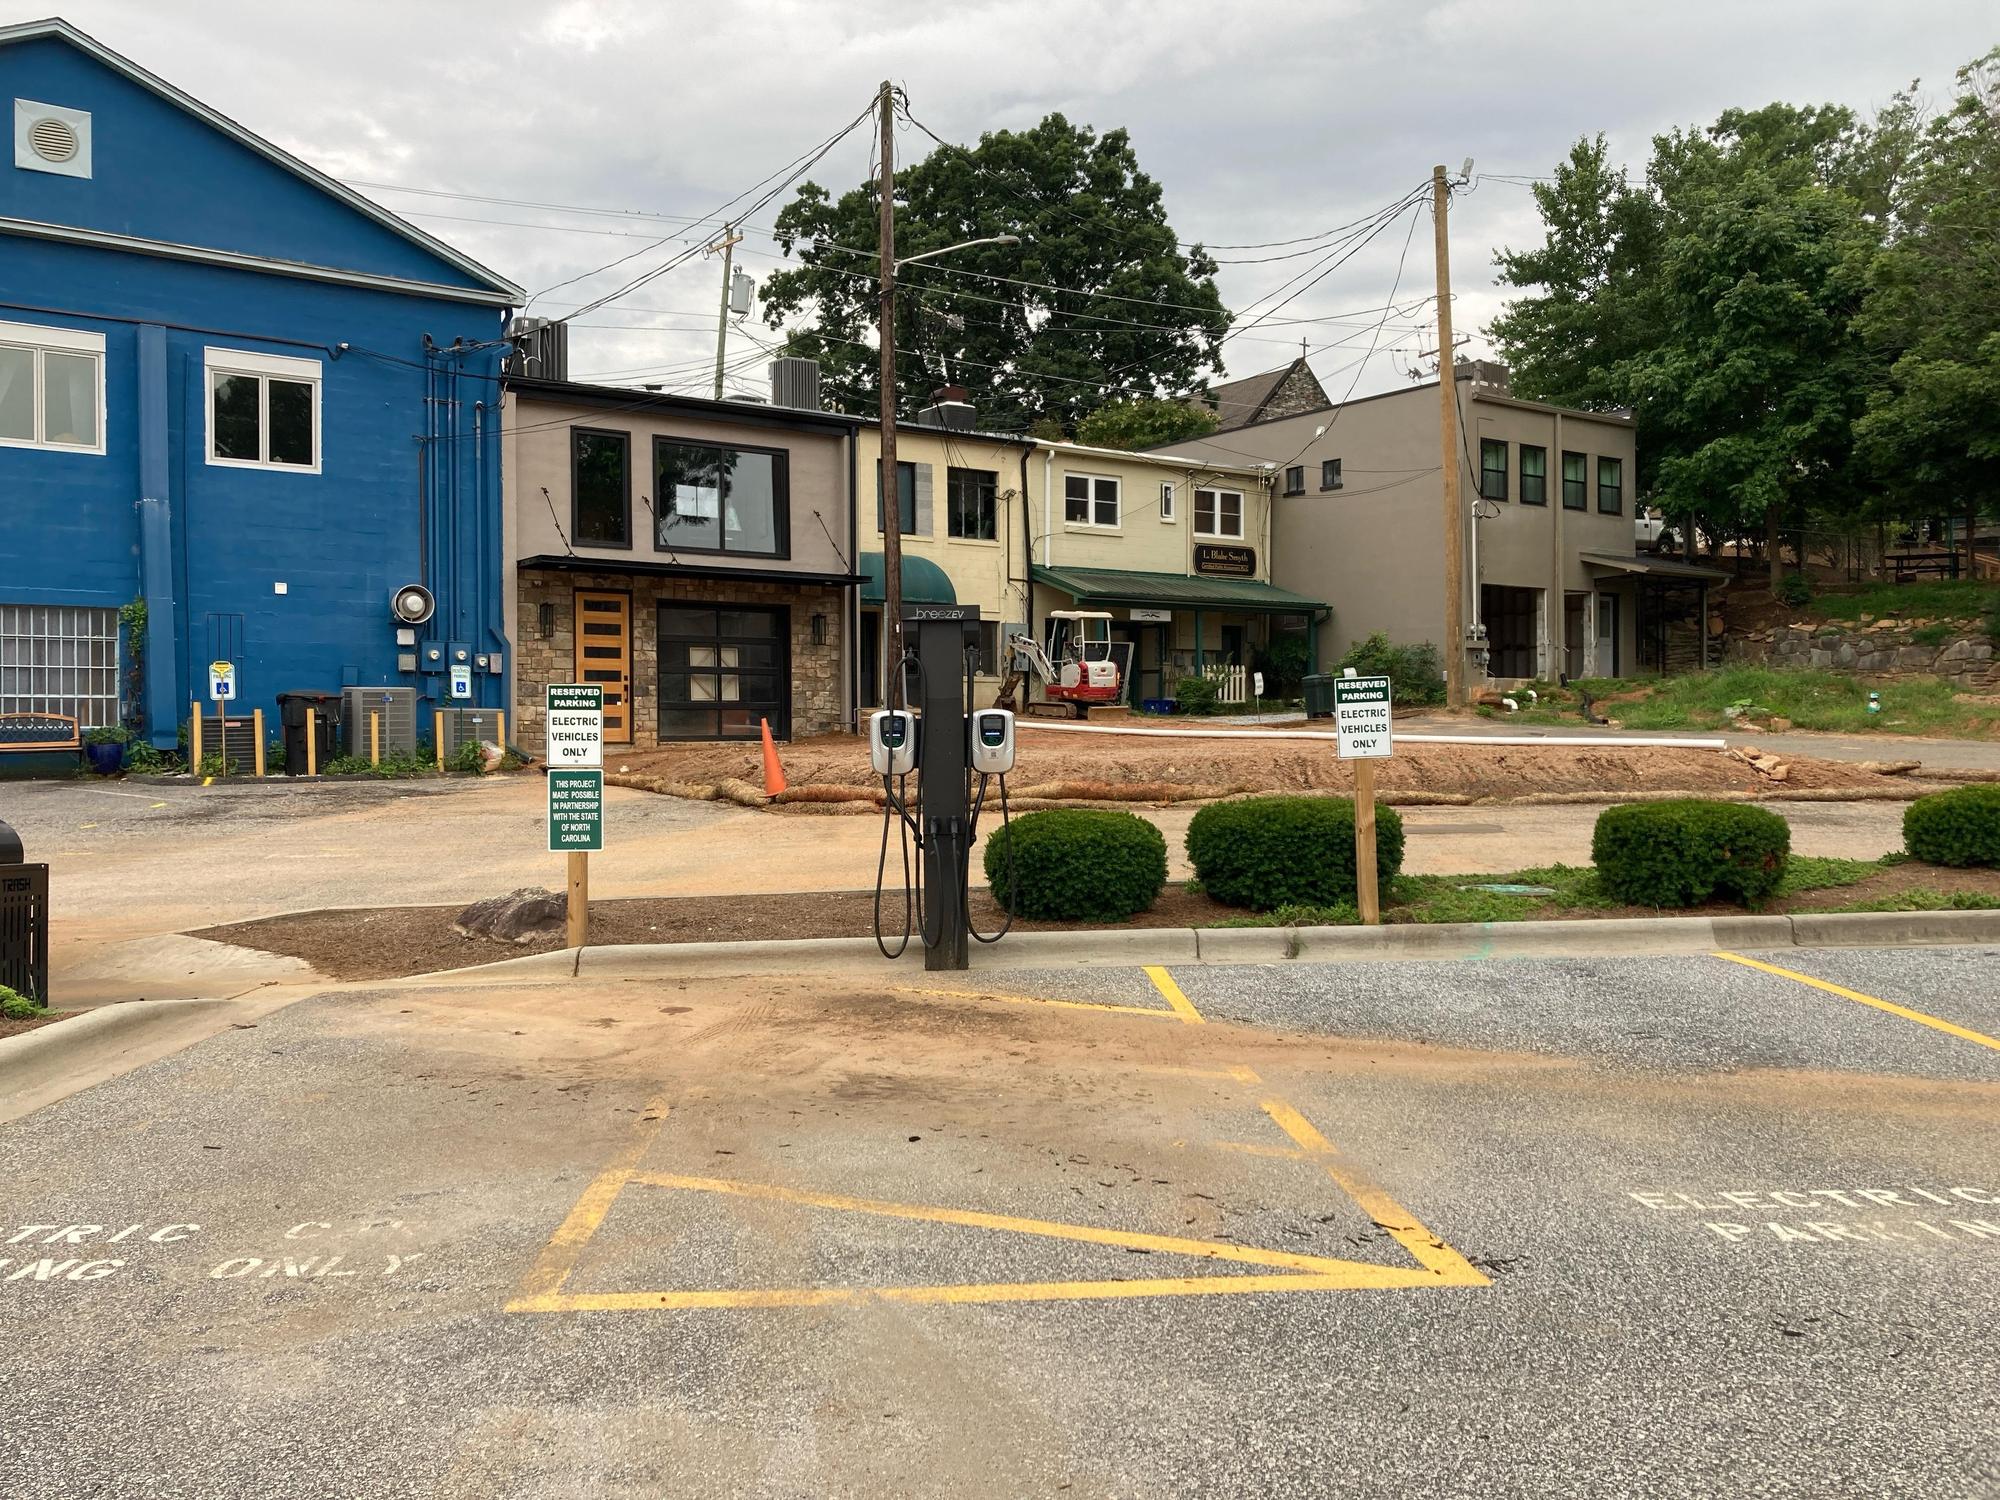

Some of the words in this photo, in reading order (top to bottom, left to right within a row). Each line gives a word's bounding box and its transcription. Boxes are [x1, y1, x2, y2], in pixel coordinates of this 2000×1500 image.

[1337, 680, 1387, 690] RESERVED
[550, 688, 600, 696] RESERVED
[1341, 691, 1384, 701] PARKING
[1341, 708, 1387, 719] ELECTRIC
[552, 717, 599, 726] ELECTRIC
[1341, 723, 1388, 734] VEHICLES
[551, 732, 599, 741] VEHICLES
[1352, 738, 1378, 748] ONLY
[562, 747, 588, 757] ONLY
[555, 780, 569, 788] THIS
[569, 780, 596, 788] PROJECT
[552, 791, 569, 799] MADE
[571, 791, 600, 799] POSSIBLE
[552, 801, 559, 810] IN
[559, 801, 599, 810] PARTNERSHIP
[552, 812, 568, 821] WITH
[568, 812, 580, 821] THE
[580, 812, 599, 821] STATE
[561, 823, 570, 832] OF
[570, 823, 591, 832] NORTH
[561, 834, 591, 843] CAROLINA
[2, 877, 32, 892] TRASH
[1628, 1187, 2000, 1210] ELECTRIC
[208, 1253, 424, 1279] ONLY
